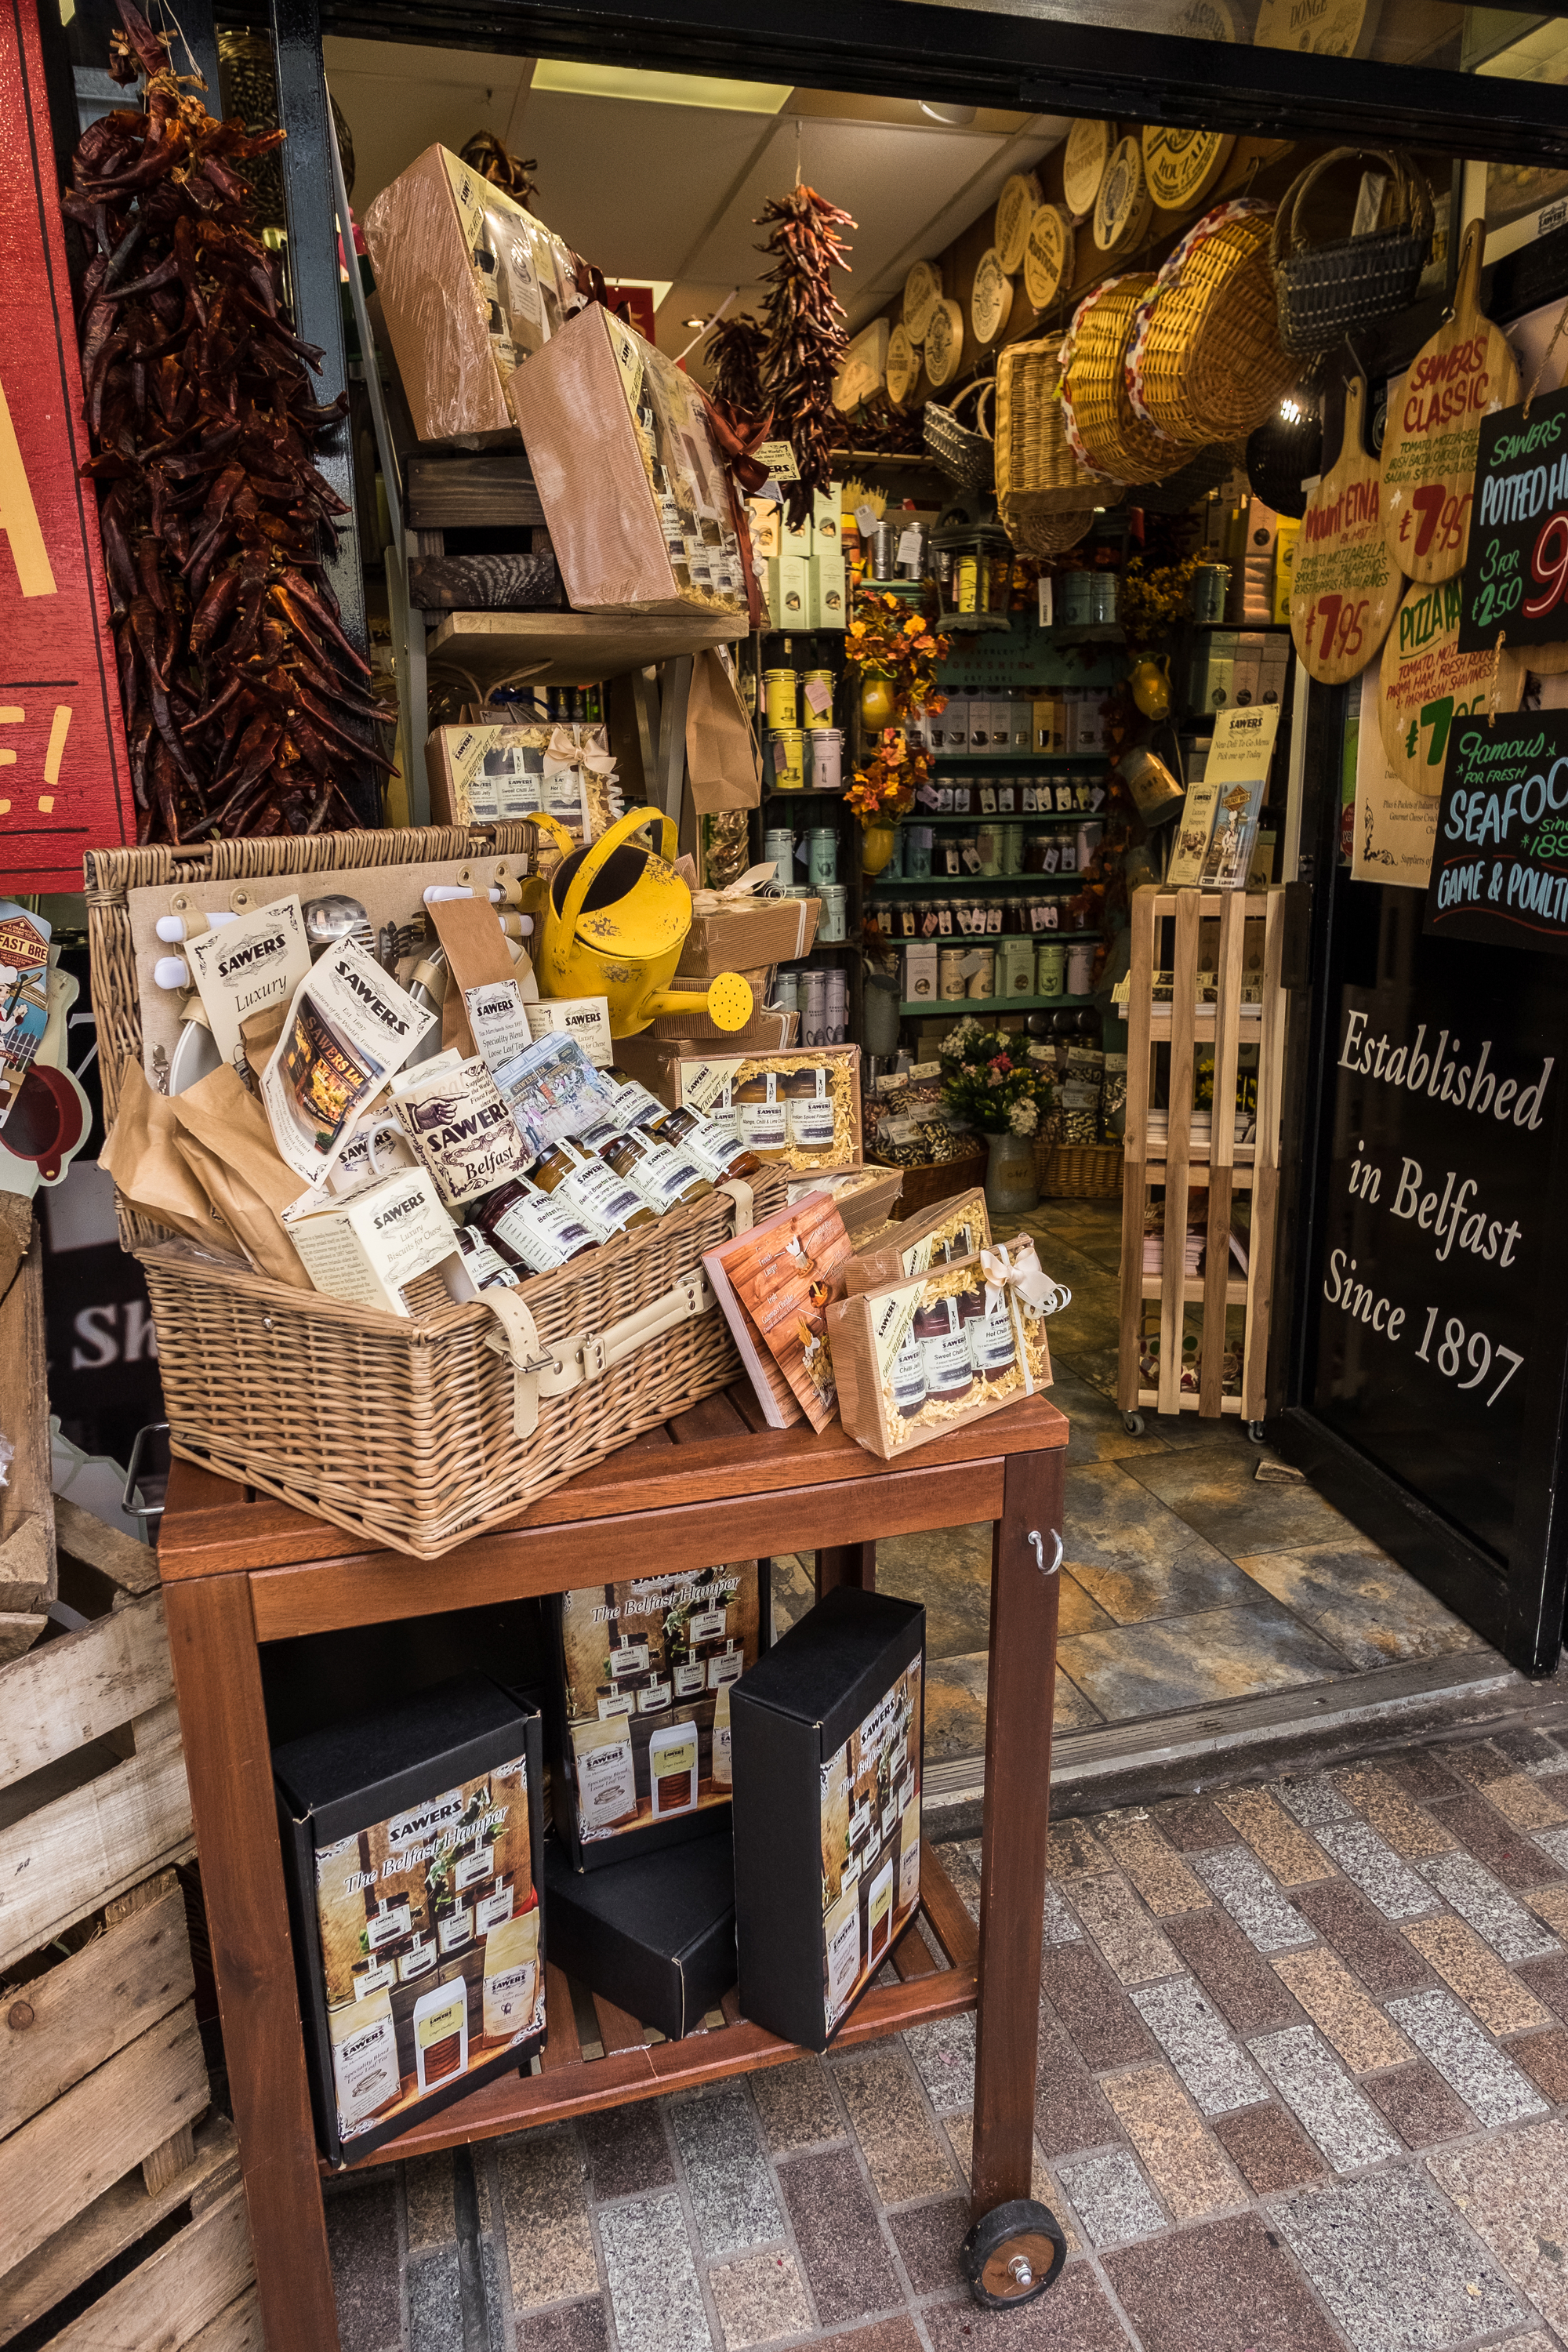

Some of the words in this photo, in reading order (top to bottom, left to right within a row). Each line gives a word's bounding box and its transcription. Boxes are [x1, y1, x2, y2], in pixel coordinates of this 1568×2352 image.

[1410, 336, 1488, 392] SAWERS
[1403, 372, 1489, 434] CLASSIC
[1490, 412, 1566, 466] SAWERS
[1345, 478, 1379, 528] ETNA
[1480, 466, 1548, 526] POTTED
[1548, 452, 1568, 510] H
[1327, 541, 1385, 564] MOZZARELLA
[1479, 539, 1500, 582] 3
[1497, 550, 1520, 576] FOR
[1399, 594, 1442, 652] PIZZA
[1386, 678, 1411, 700] PARMA
[1439, 655, 1467, 680] FRESH
[1448, 662, 1492, 691] SHAVINGS
[1229, 717, 1263, 729] SAWERS
[456, 733, 473, 760] SAWERS
[1246, 750, 1262, 760] Today
[1458, 731, 1545, 773] Famous
[459, 779, 469, 792] CHILLI
[468, 753, 485, 778] SELECTION
[1464, 770, 1486, 785] FOR
[1487, 764, 1527, 783] FRESH
[1437, 861, 1486, 909] GAME
[1487, 862, 1504, 902] &
[2, 927, 24, 936] WALKING
[218, 934, 286, 978] SAWERS
[235, 975, 287, 1013] Luxury
[334, 960, 410, 1036] SAWERS
[477, 1000, 514, 1016] SAWERS
[307, 982, 330, 1009] Suppliers
[342, 1019, 361, 1041] World's
[359, 1039, 377, 1054] Finest
[376, 1051, 392, 1067] Foods
[342, 1007, 354, 1020] Est.
[353, 1018, 367, 1032] 1897
[565, 1012, 601, 1026] SAWERS
[307, 1016, 350, 1073] SAWERS
[483, 1035, 508, 1049] Speciality
[509, 1029, 523, 1040] Blend
[488, 1049, 502, 1058] Loose
[503, 1043, 514, 1054] Leaf
[515, 1042, 524, 1051] Tea
[465, 1076, 484, 1089] Suppliers
[513, 1074, 537, 1093] SAWERS
[687, 1066, 710, 1094] SAWERS
[712, 1082, 721, 1095] GIFT
[1337, 1009, 1555, 1131] Established
[470, 1093, 485, 1105] Finest
[426, 1099, 510, 1152] SAWERS
[339, 1131, 392, 1163] SAWRS
[465, 1145, 514, 1181] Belfast
[372, 1192, 426, 1230] SAWERS
[537, 1209, 556, 1223] Belfast
[1348, 1140, 1380, 1204] in
[1389, 1156, 1523, 1268] Belfast
[387, 1242, 415, 1263] Biscuits
[414, 1236, 424, 1247] for
[424, 1225, 443, 1240] Cheese
[400, 1225, 424, 1243] Luxury
[757, 1253, 773, 1267] French
[878, 1300, 896, 1338] SAWERS
[883, 1357, 894, 1378] CHILLI
[892, 1319, 909, 1356] SELECTION
[913, 1287, 921, 1304] SET
[1323, 1249, 1406, 1341] Since
[1414, 1306, 1525, 1407] 1897
[591, 1606, 620, 1623] The
[625, 1593, 675, 1615] Belfast
[681, 1577, 740, 1602] Hamper
[861, 1697, 895, 1745] SAWERS
[586, 1751, 623, 1767] SAWERS
[390, 1798, 463, 1842] SAWERS
[344, 1868, 377, 1894] The
[383, 1838, 441, 1878] Belfast
[445, 1806, 508, 1845] Hamper
[492, 1974, 526, 1990] SAWERS
[430, 2009, 452, 2025] SAWERS
[343, 2029, 384, 2058] SAWERS
[343, 2059, 372, 2081] Speciality
[373, 2047, 390, 2063] Blend
[347, 2070, 364, 2084] Loose
[364, 2063, 376, 2074] Leaf
[376, 2056, 388, 2067] Tea
